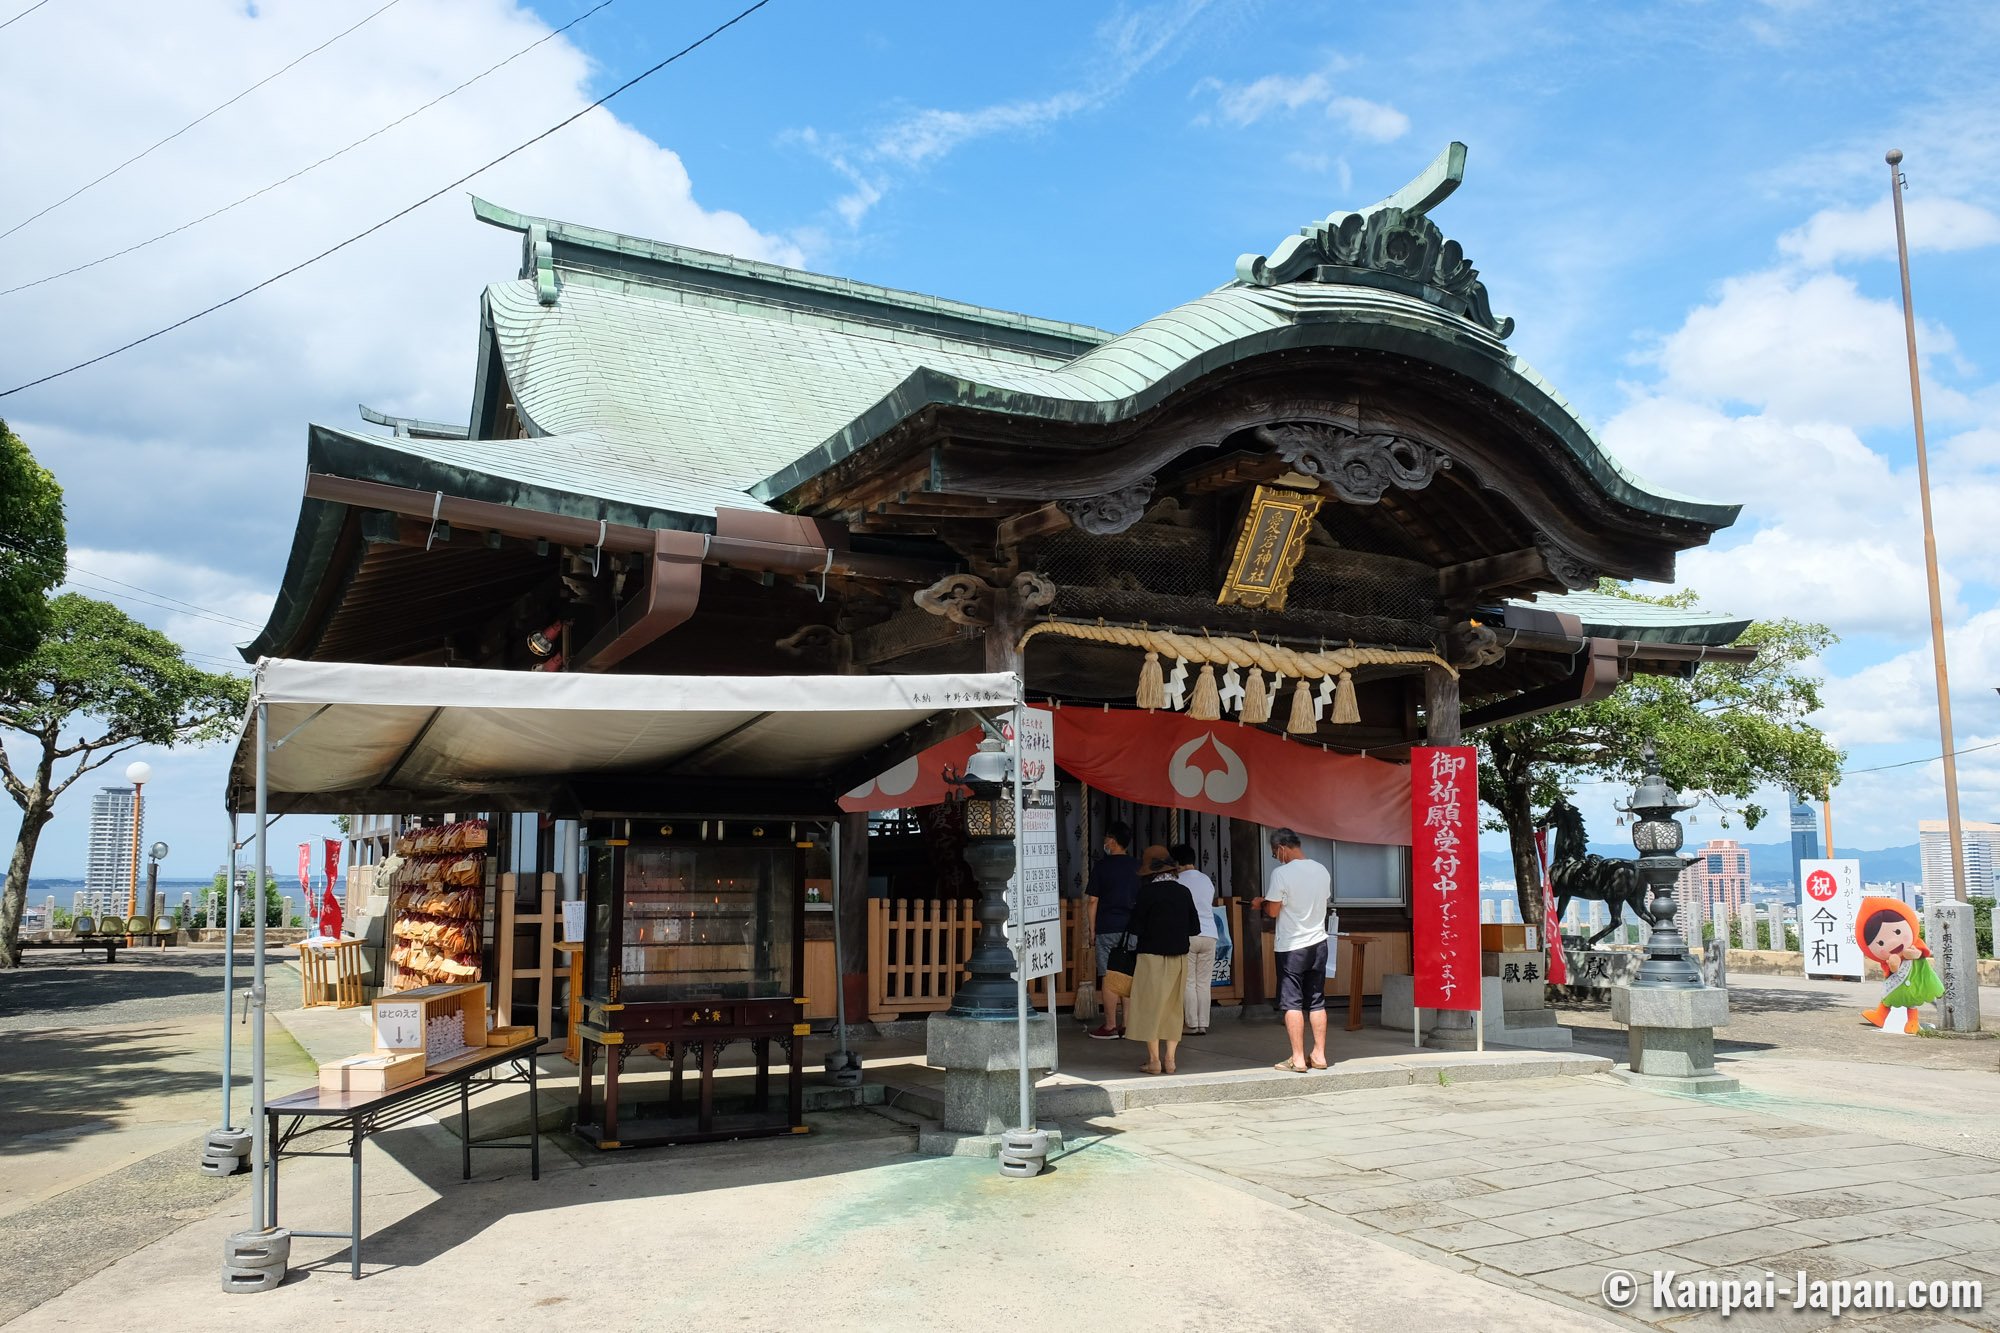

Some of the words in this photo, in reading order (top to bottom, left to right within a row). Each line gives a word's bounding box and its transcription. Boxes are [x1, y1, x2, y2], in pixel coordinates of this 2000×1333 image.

[1245, 510, 1285, 583] 愛宕神社
[1025, 883, 1032, 893] 44
[1424, 751, 1466, 1001] 御祈願受付中でございます
[1811, 875, 1832, 897] 祝
[1843, 865, 1857, 945] ありがとう平成
[1024, 927, 1047, 950] 除祈願
[1810, 906, 1839, 967] 令和
[379, 1008, 419, 1019] はとのえさ
